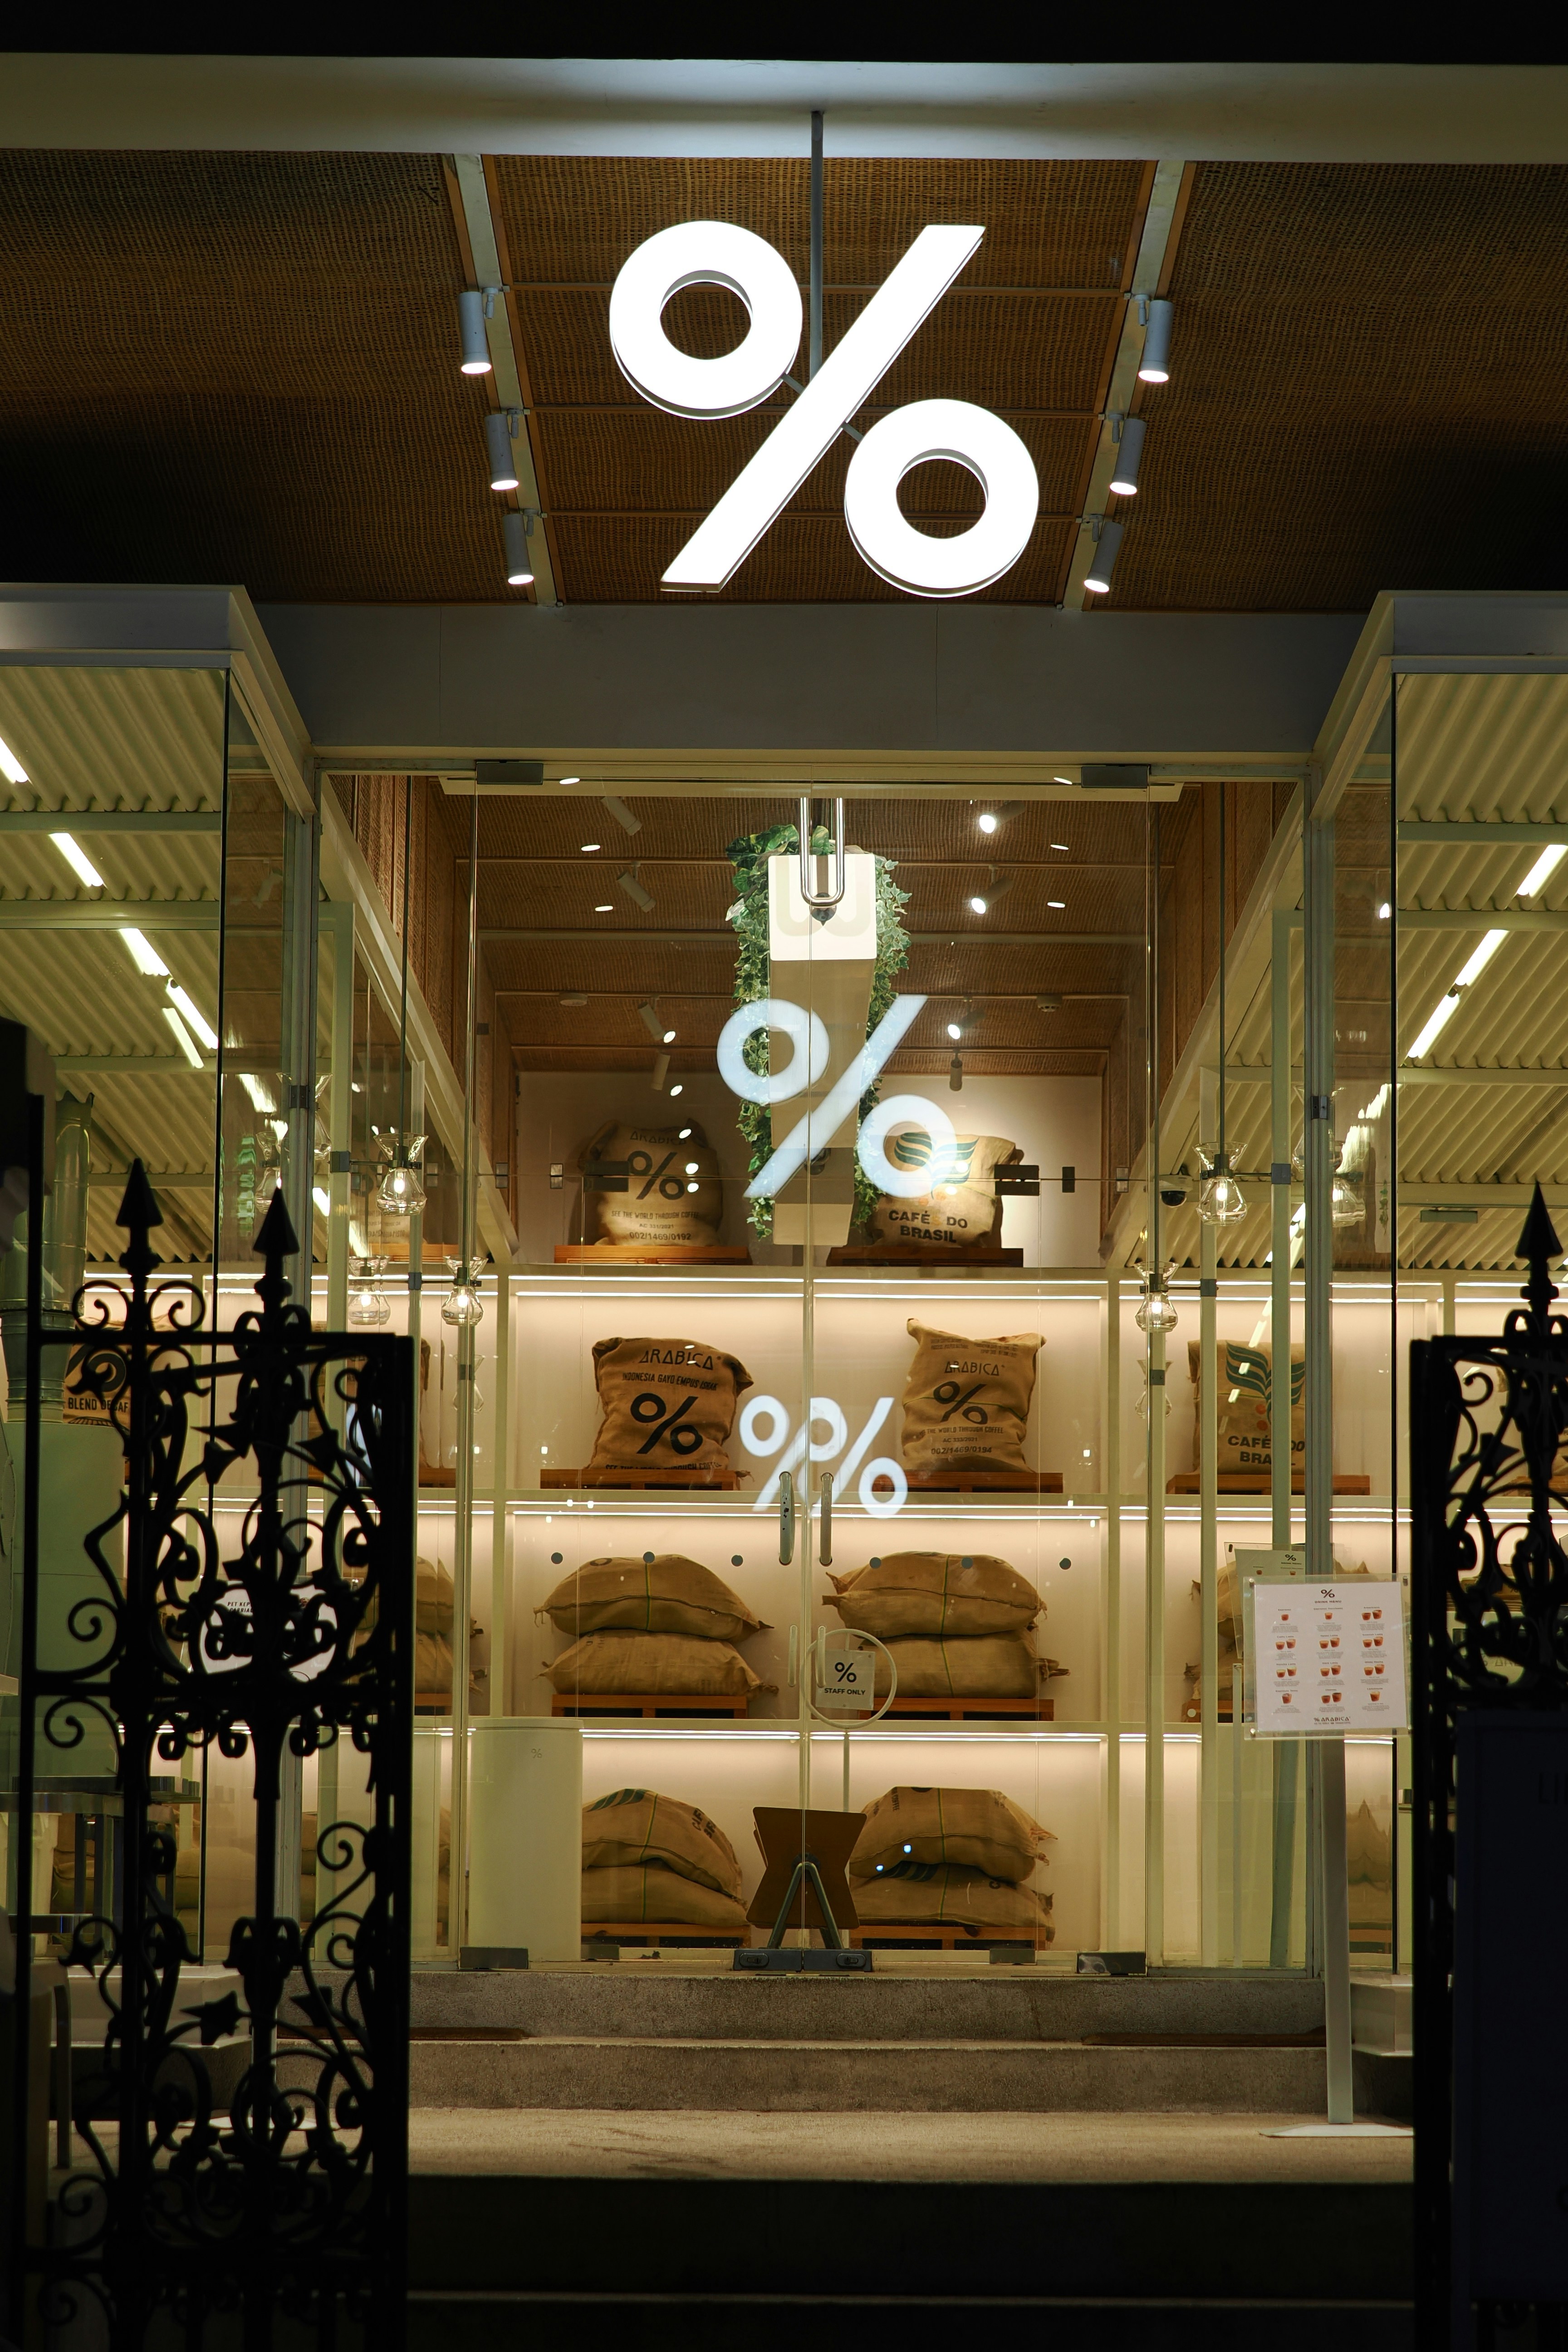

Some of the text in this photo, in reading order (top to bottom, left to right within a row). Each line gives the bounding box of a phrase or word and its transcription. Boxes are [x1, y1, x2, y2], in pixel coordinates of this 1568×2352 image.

[609, 220, 1039, 598] %
[888, 1210, 968, 1229] CAFÉ DO
[900, 1225, 957, 1244] BRASIL
[638, 1349, 713, 1370] ARABICA
[944, 1361, 1000, 1376] ARABICA
[622, 1372, 655, 1382] INDONESIA
[657, 1374, 675, 1384] GAYO
[68, 1397, 128, 1412] BLEND DEAF
[1228, 1435, 1271, 1449] CAFÉ
